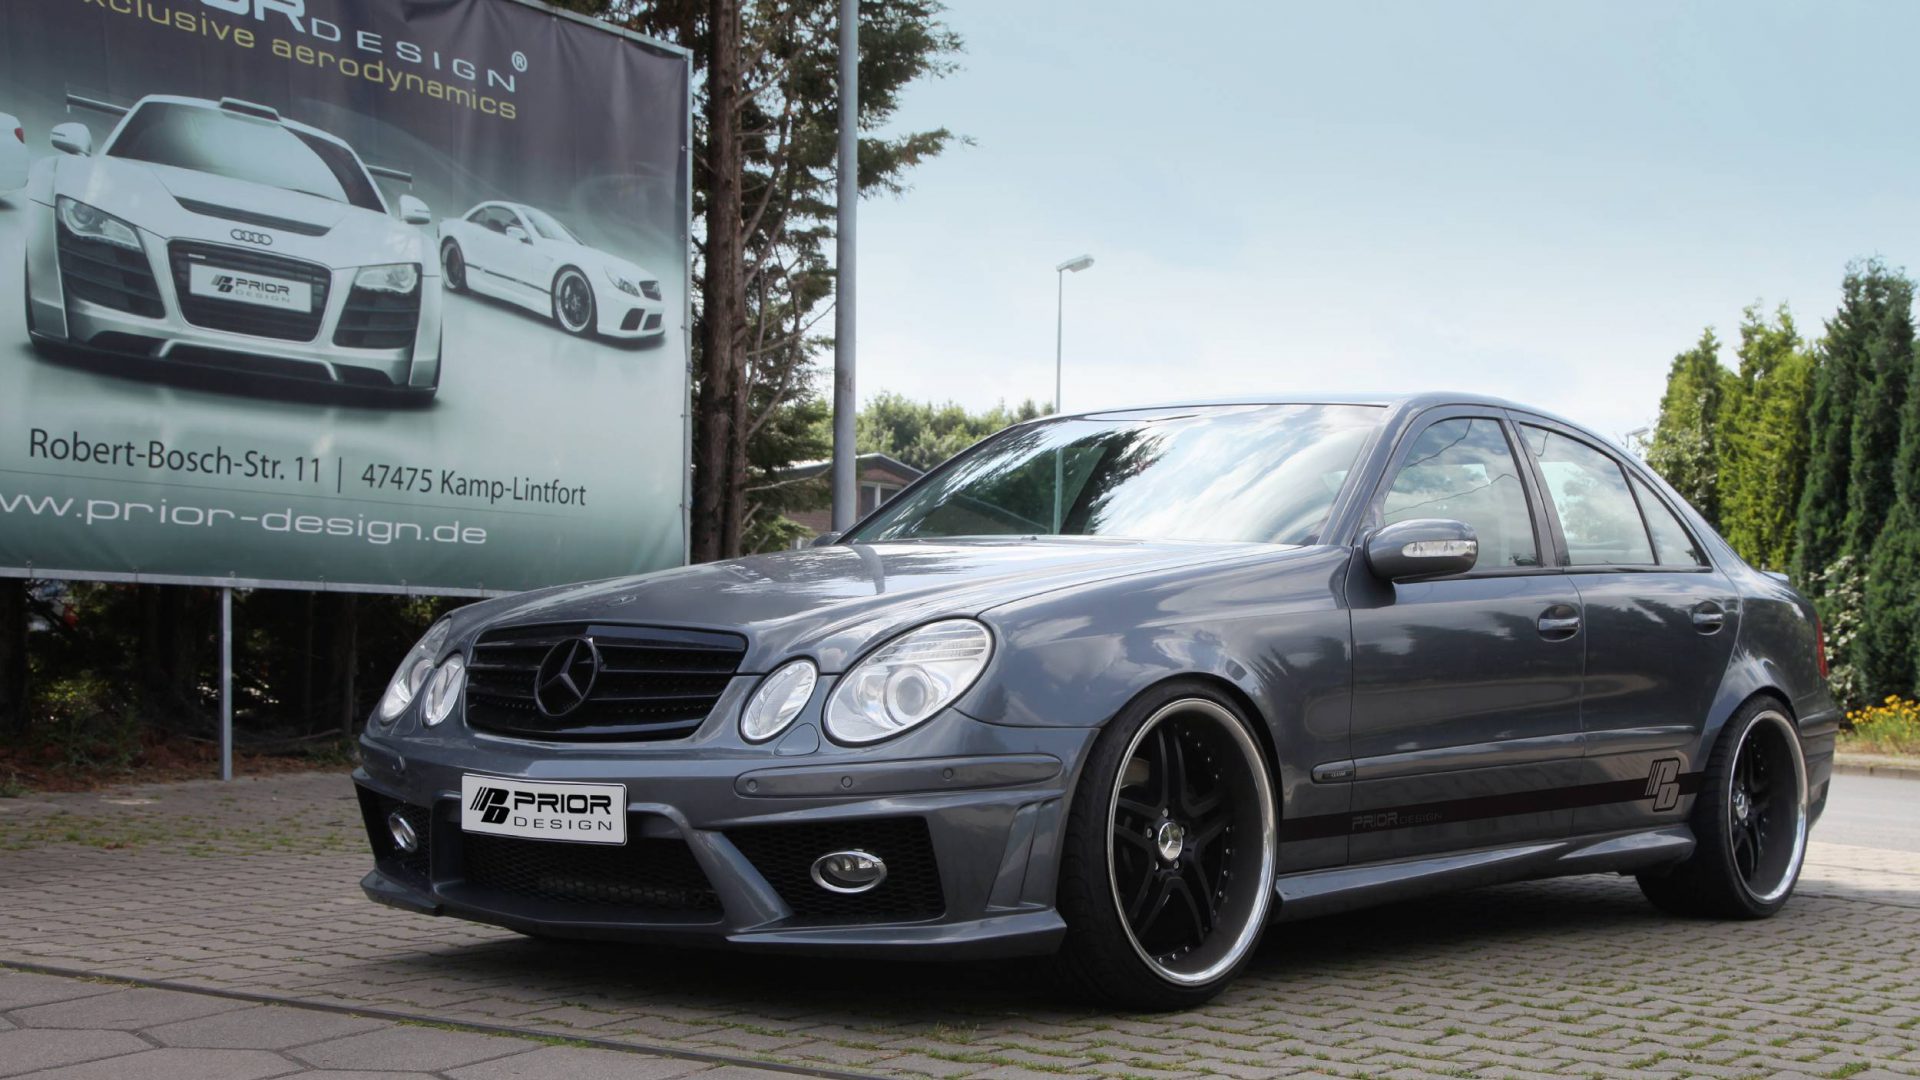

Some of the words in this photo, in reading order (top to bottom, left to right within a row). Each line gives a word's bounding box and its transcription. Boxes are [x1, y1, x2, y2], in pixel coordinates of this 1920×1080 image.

[271, 38, 516, 119] aerodynamics
[235, 277, 290, 295] PRIOR
[29, 428, 285, 480] Robert-Bosch-Str.
[295, 456, 320, 483] 11
[361, 463, 433, 493] 47475
[440, 470, 587, 505] Kamp-Lintfort
[514, 790, 611, 815] PRIOR
[514, 816, 612, 831] DESIGN
[1352, 811, 1398, 832] PRIOR
